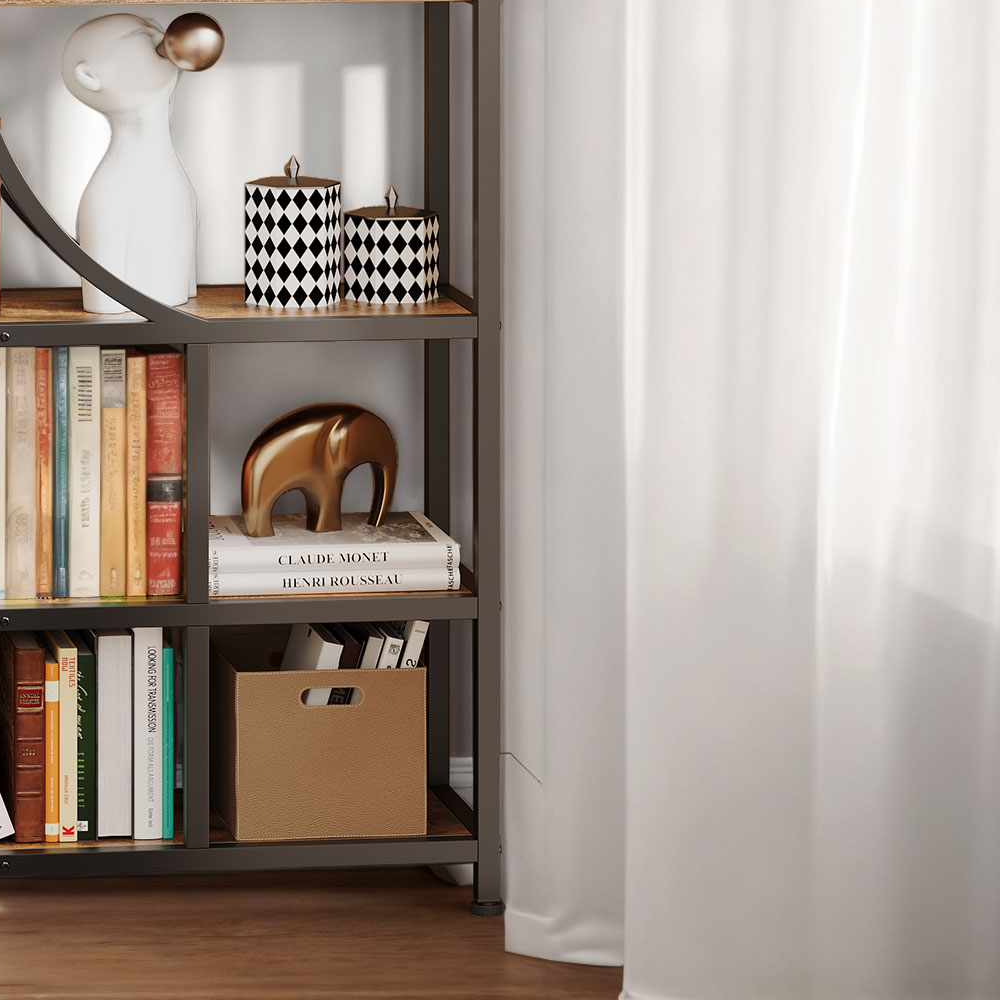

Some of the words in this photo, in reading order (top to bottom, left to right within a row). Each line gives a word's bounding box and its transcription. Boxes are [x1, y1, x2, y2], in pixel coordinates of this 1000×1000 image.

[278, 553, 334, 566] CLAUDE
[339, 551, 389, 564] MONET
[283, 576, 325, 588] HENRI
[330, 574, 403, 587] ROUSSEAU
[147, 646, 157, 674] LOOKING
[147, 675, 157, 687] FOR
[147, 688, 157, 733] TRANSMISSION
